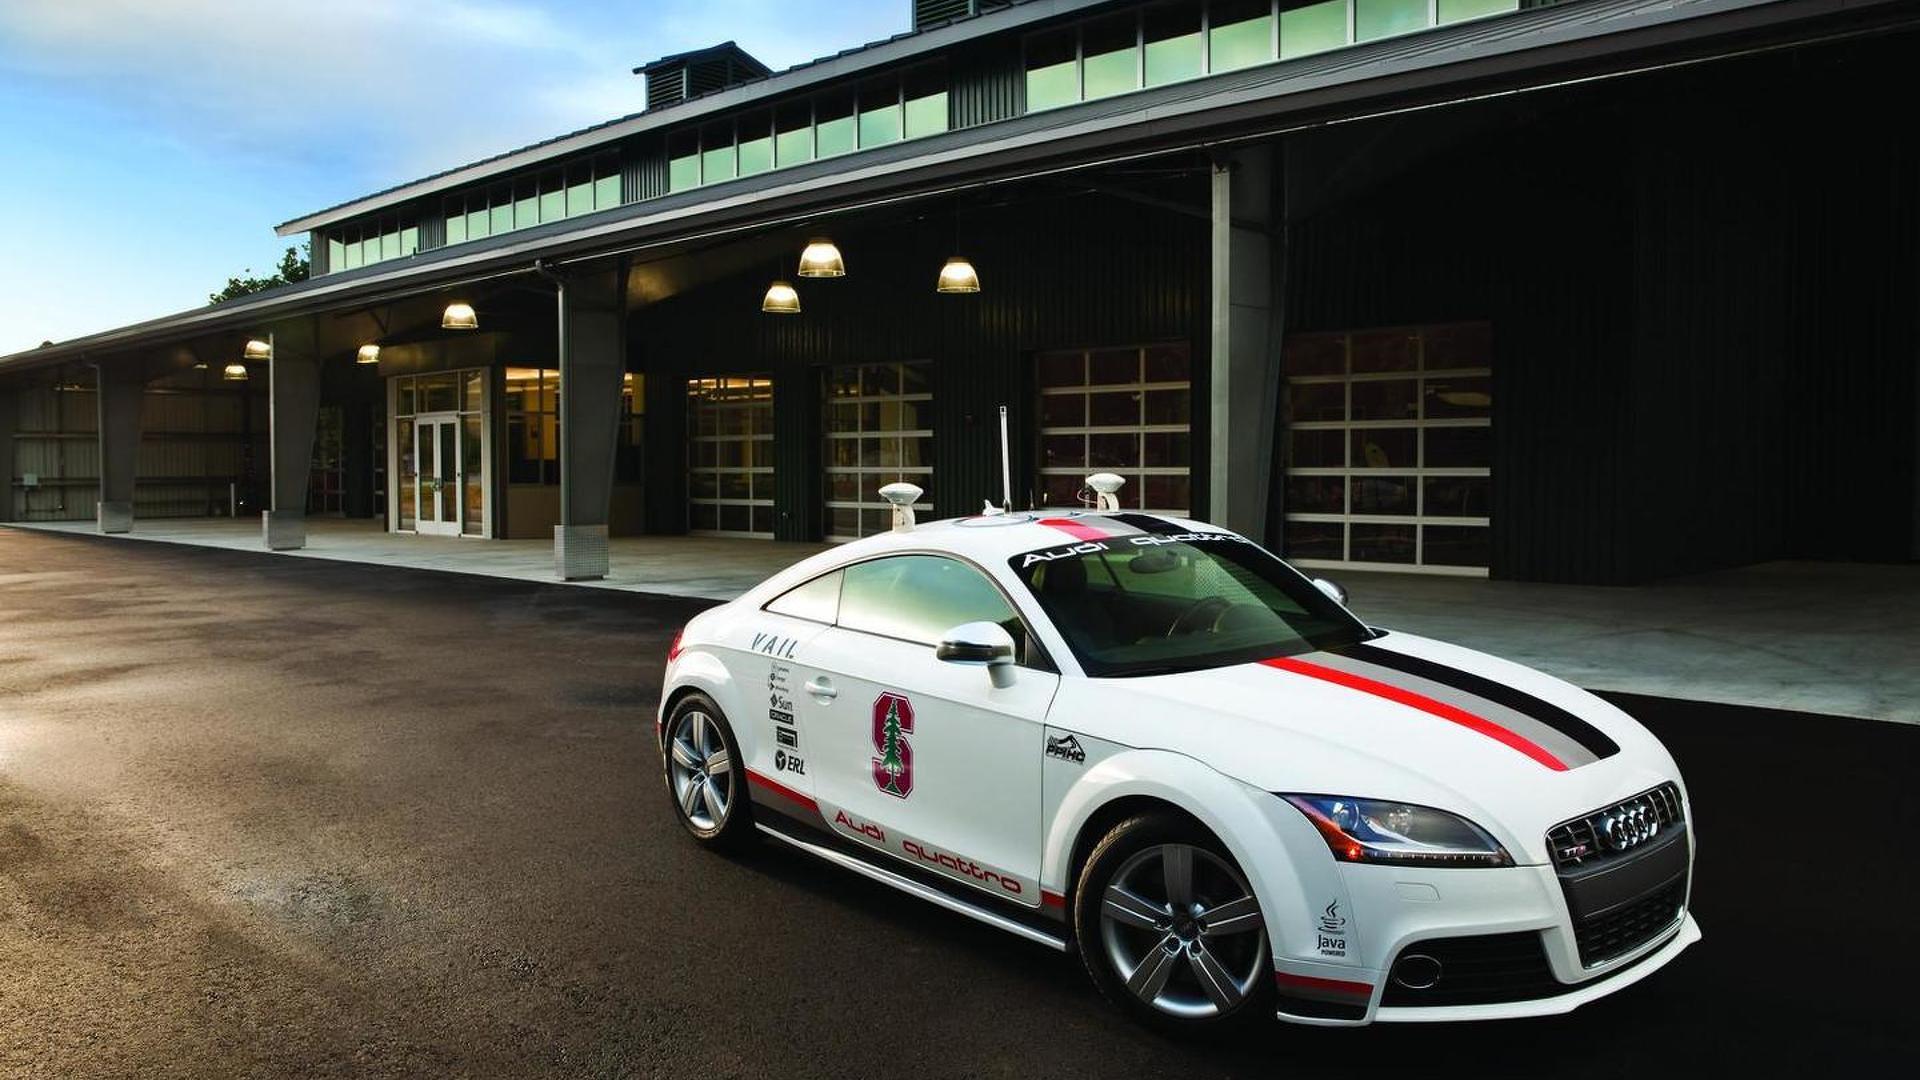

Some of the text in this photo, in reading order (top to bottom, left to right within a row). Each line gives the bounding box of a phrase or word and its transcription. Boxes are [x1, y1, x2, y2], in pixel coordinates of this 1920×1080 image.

[1022, 532, 1251, 568] Audi quattro
[751, 632, 798, 659] VAIL
[778, 695, 793, 711] Sun
[771, 710, 793, 724] ORACLE
[787, 755, 806, 776] ERL
[835, 810, 1022, 894] Audi quattro
[1317, 934, 1346, 950] Java
